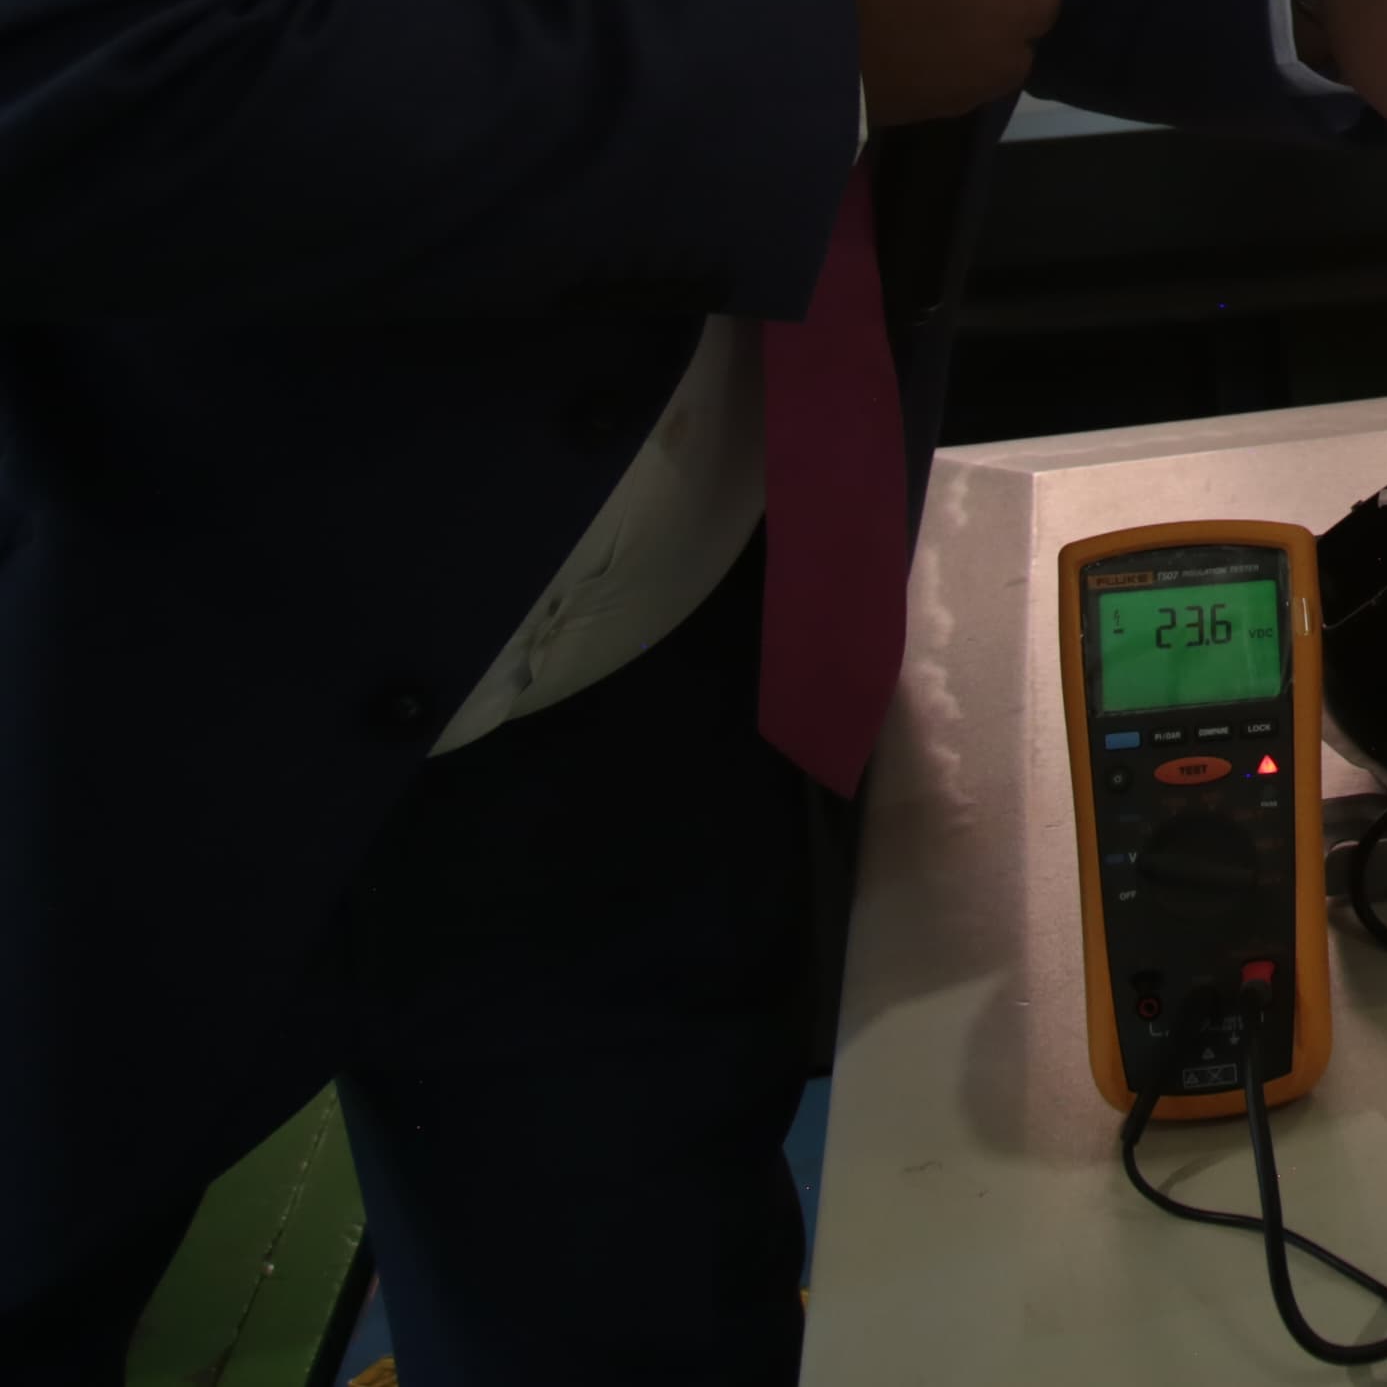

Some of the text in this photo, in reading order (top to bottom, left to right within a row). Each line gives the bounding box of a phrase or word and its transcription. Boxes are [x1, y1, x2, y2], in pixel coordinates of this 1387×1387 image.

[1155, 604, 1273, 649] 23.6 VDC
[1247, 723, 1271, 733] LOCK
[1178, 764, 1208, 775] TEST
[1119, 890, 1137, 901] OFF
